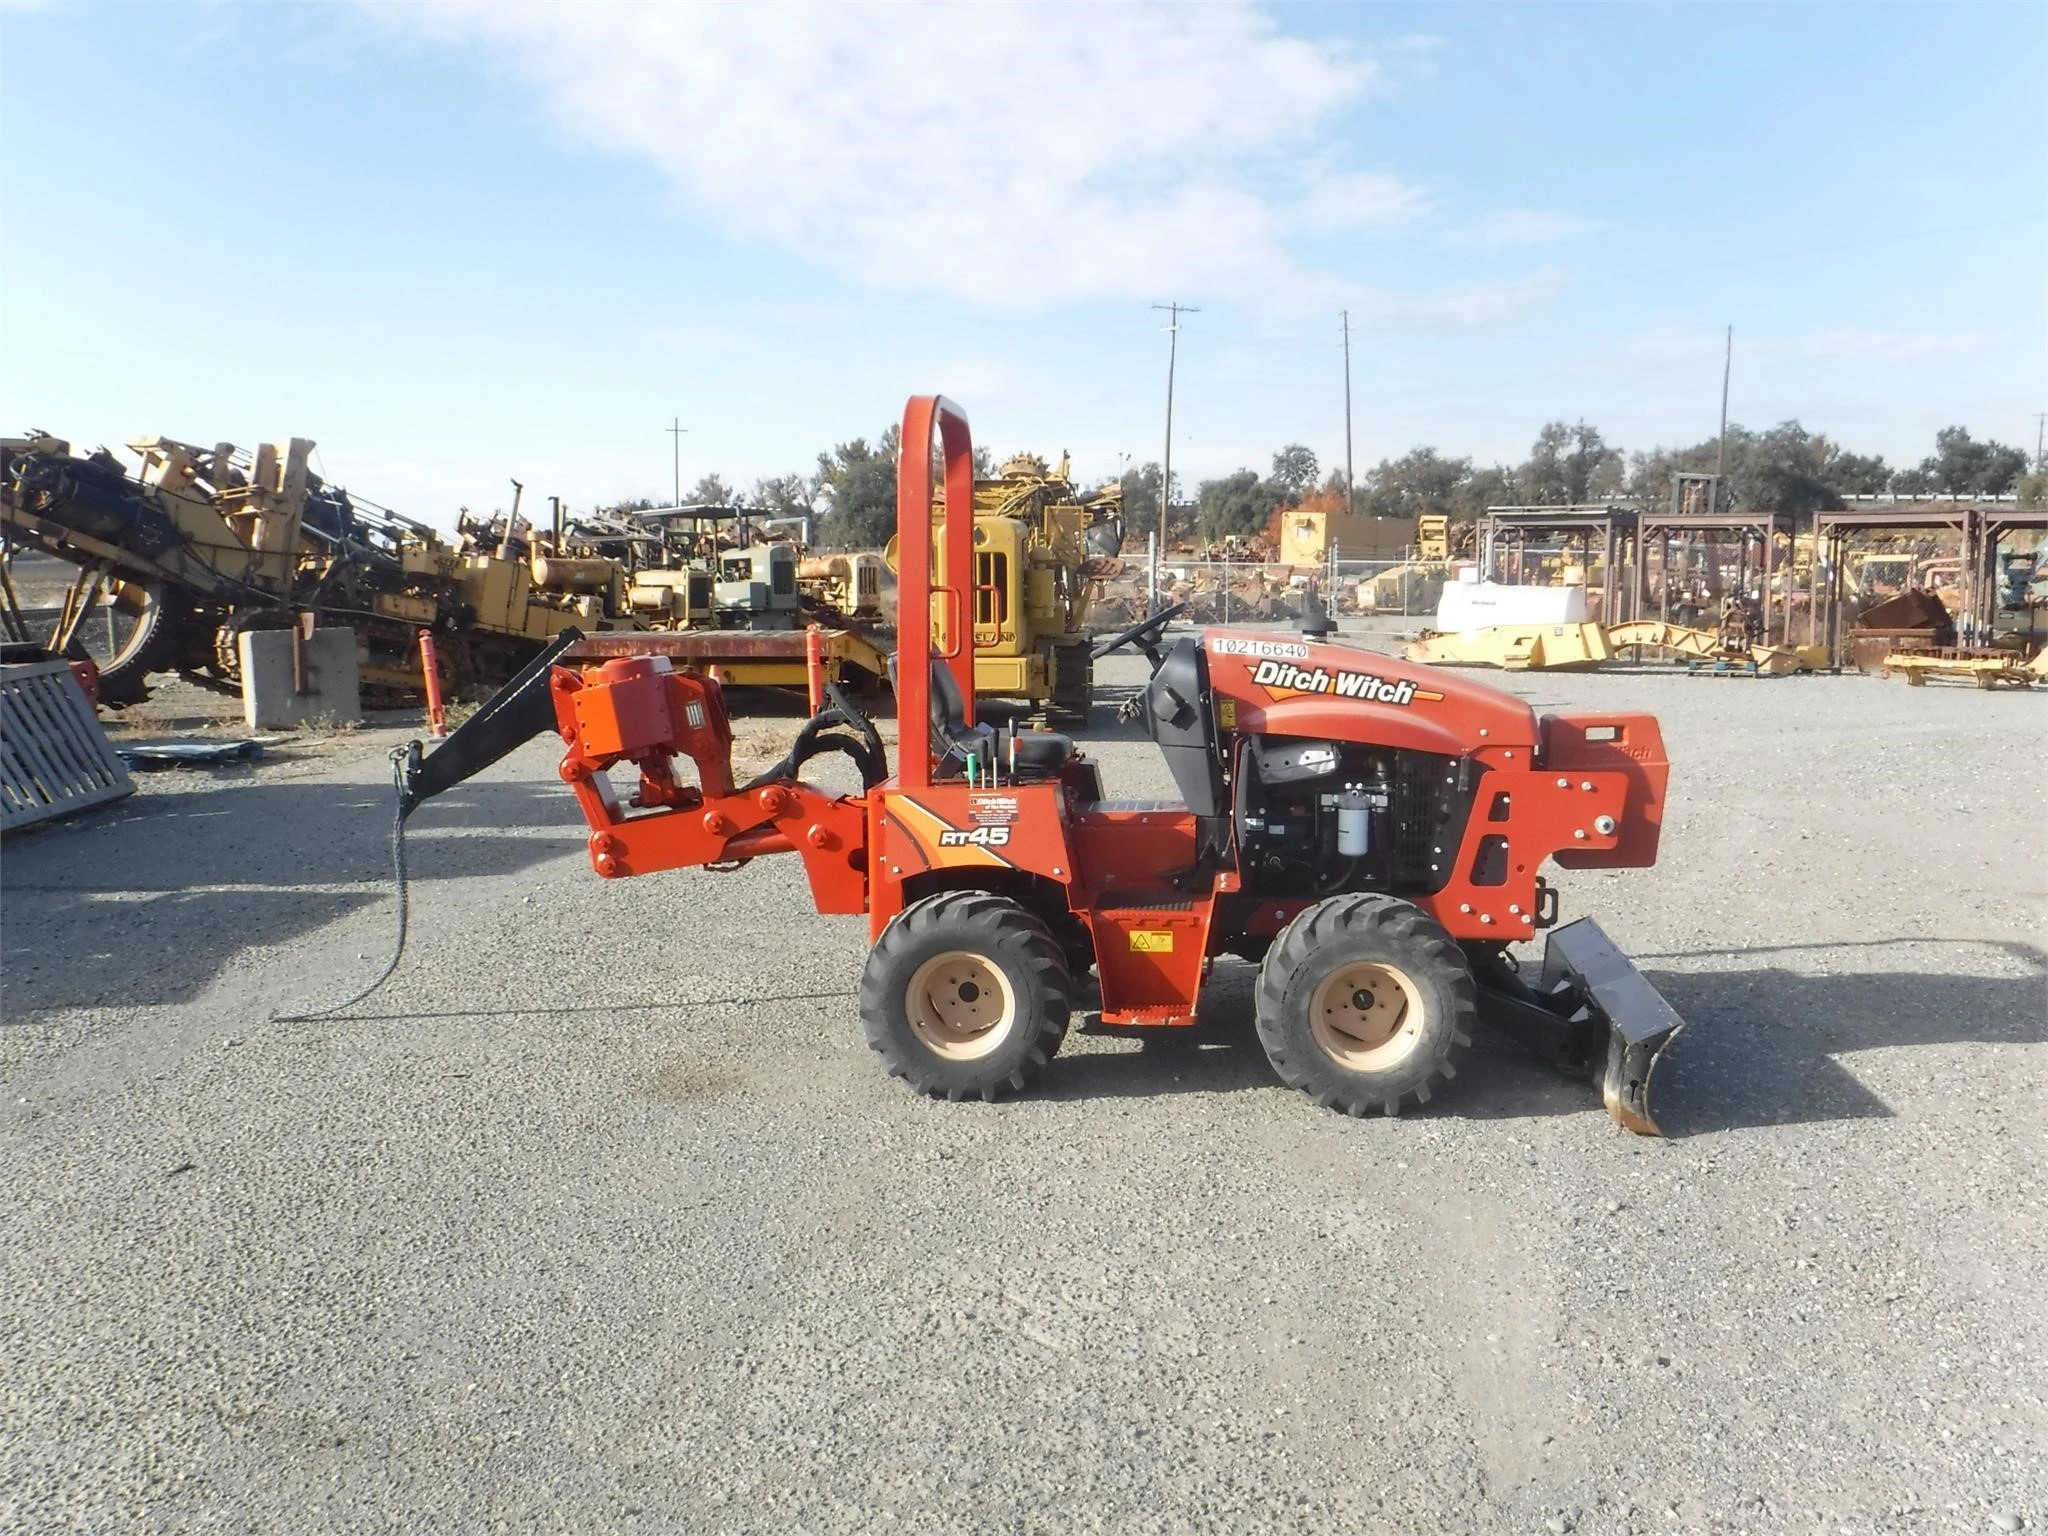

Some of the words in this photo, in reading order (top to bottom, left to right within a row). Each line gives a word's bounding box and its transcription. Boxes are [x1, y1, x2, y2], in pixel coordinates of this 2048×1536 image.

[1216, 639, 1307, 658] 10216640
[1253, 660, 1330, 693] Ditch
[1335, 671, 1414, 705] Witch
[941, 827, 1010, 845] RT45
